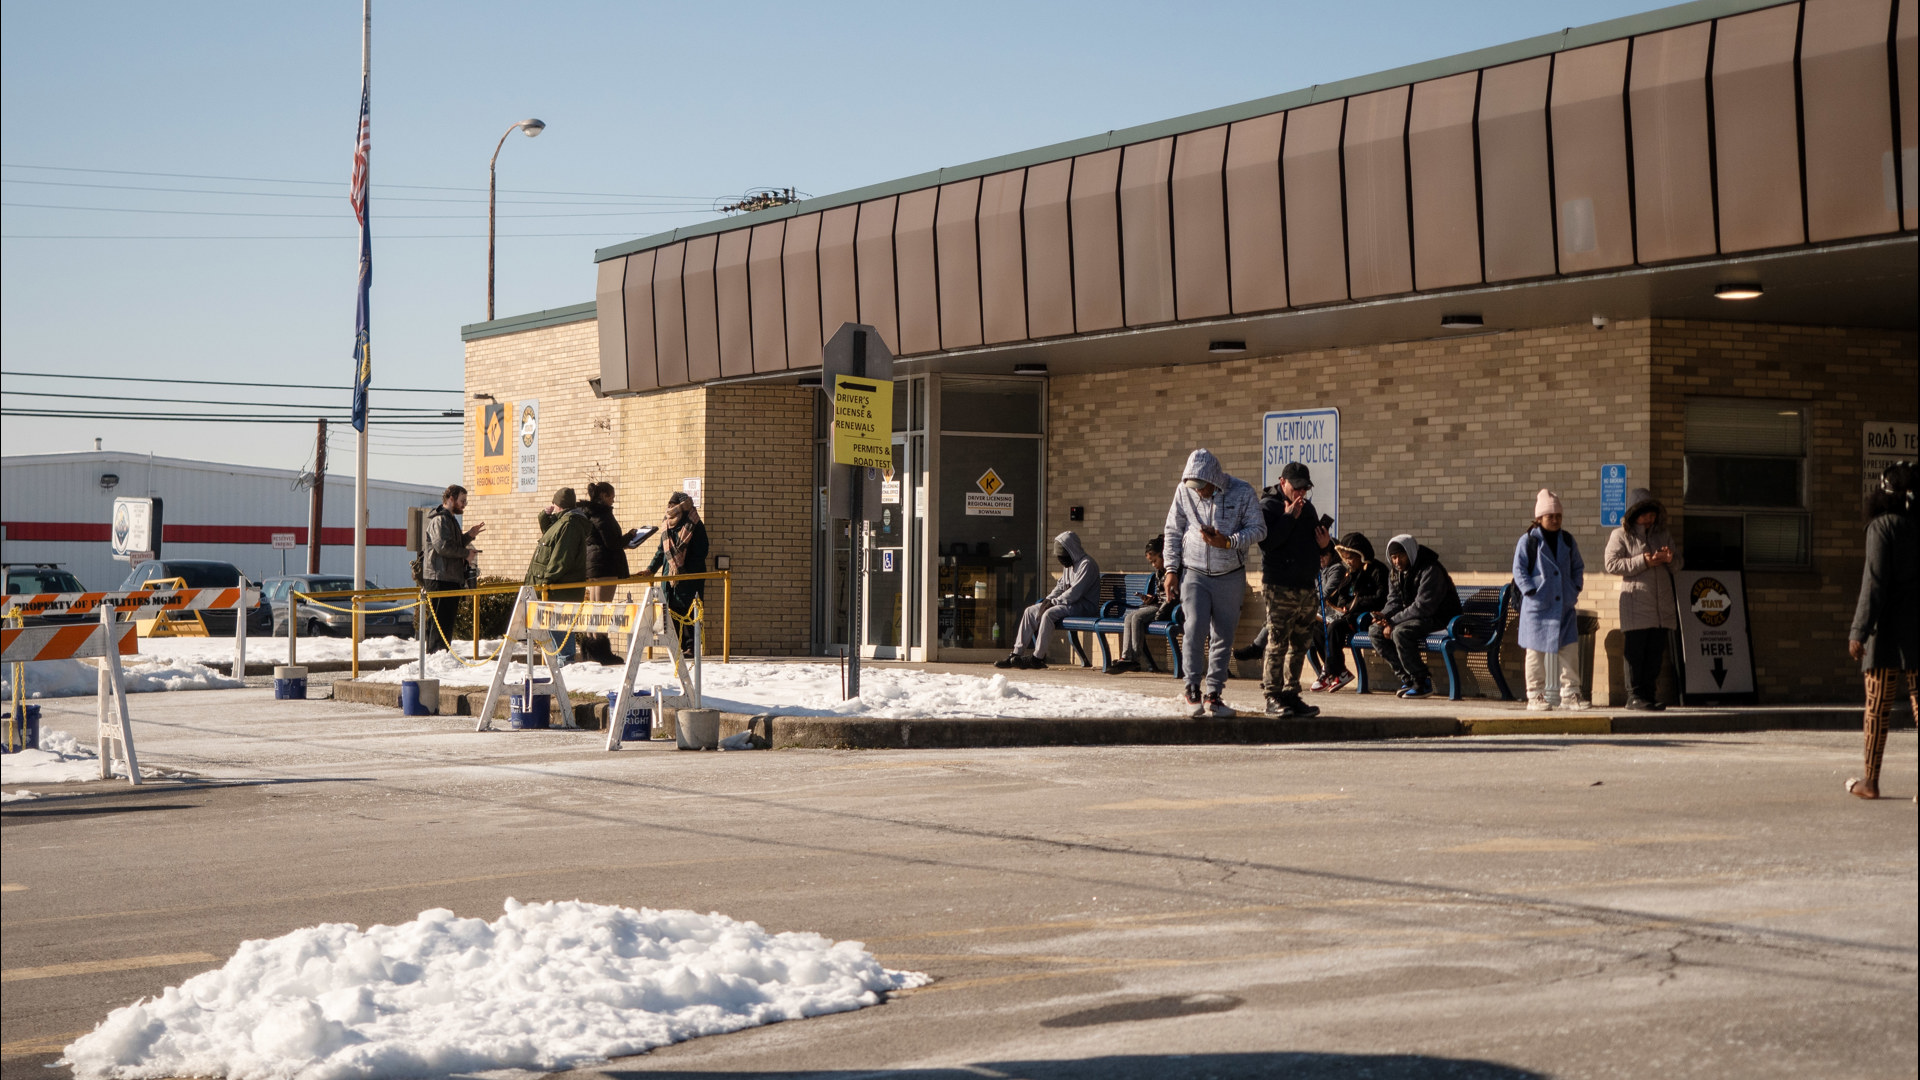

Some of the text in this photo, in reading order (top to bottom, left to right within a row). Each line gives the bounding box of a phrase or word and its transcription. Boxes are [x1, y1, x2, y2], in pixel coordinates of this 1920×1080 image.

[836, 393, 870, 405] DRIVER'S
[836, 406, 873, 419] LICENSE &
[835, 419, 875, 432] RENEWALS
[1276, 420, 1325, 441] KENTUCKY
[1868, 432, 1918, 449] ROAD TE
[853, 443, 891, 456] PERMITS &
[1268, 443, 1334, 465] STATE POLICE
[521, 455, 536, 463] DRIVER
[853, 457, 891, 469] ROAD TEST
[477, 464, 511, 474] DRIVER LICENSING
[521, 466, 536, 475] TESTING
[477, 477, 510, 486] REGIONAL OFFICE
[521, 477, 536, 486] BRANCH
[1693, 577, 1725, 596] KENTUCKY
[14, 596, 183, 612] PROPERTY OF FACILITIES MGMT
[1701, 599, 1723, 608] STATE
[586, 613, 614, 626] FACILITIES
[614, 614, 630, 627] MGMT
[1701, 612, 1727, 625] POLICE
[1701, 643, 1733, 656] HERE
[624, 716, 650, 725] RIGHT
